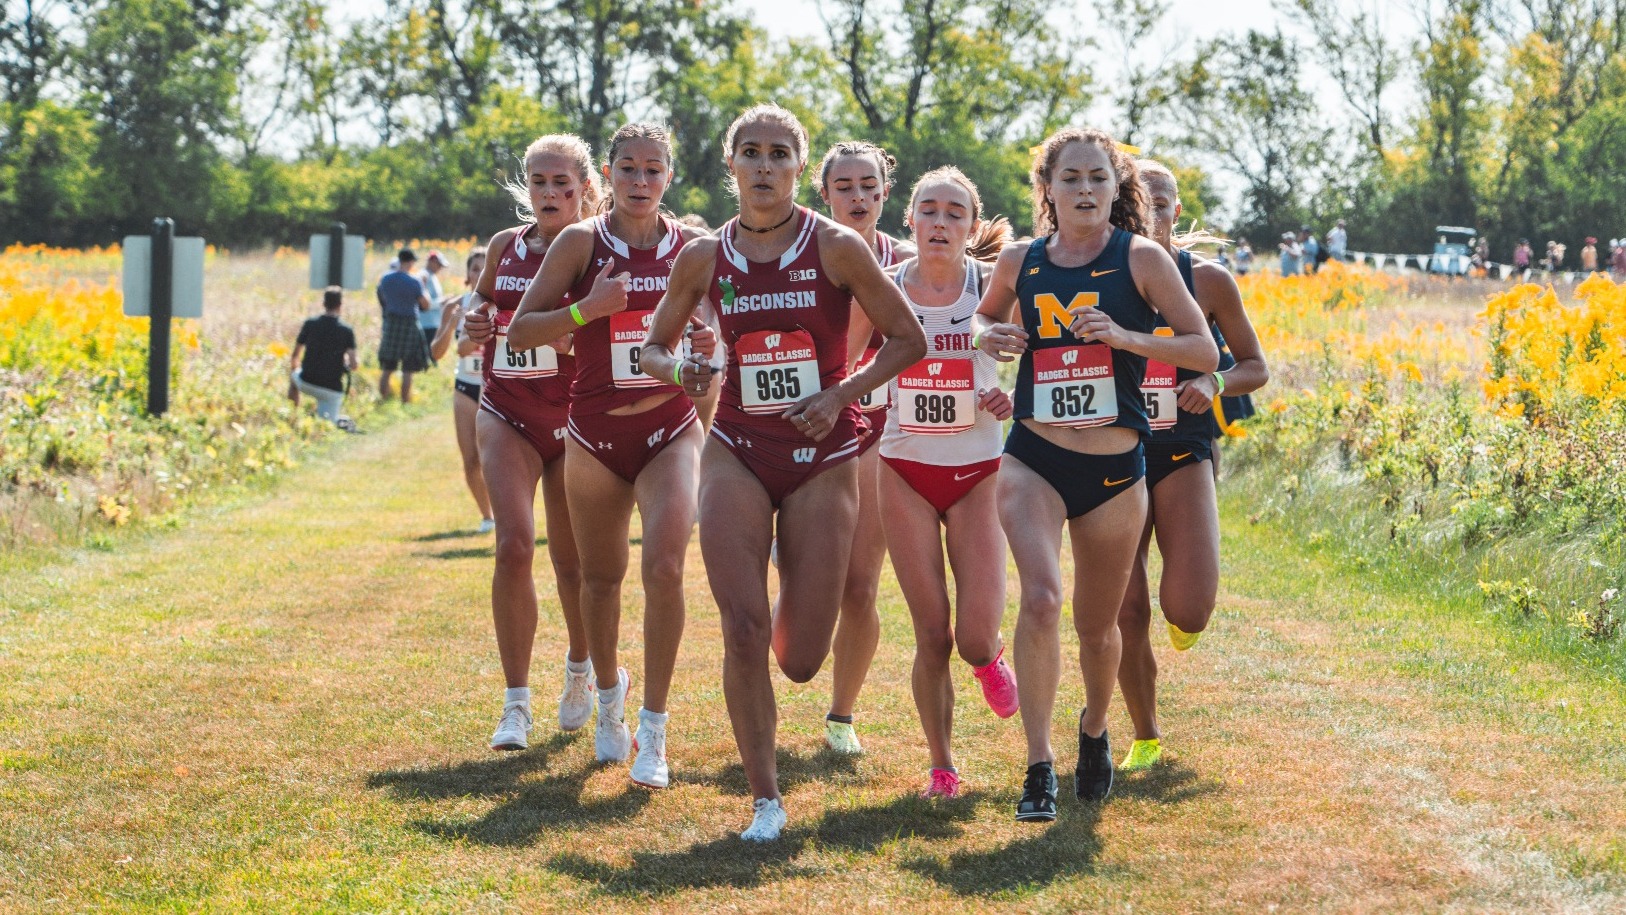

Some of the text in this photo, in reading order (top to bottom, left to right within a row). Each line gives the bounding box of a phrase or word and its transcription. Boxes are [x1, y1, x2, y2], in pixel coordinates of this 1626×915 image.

[721, 290, 817, 315] WISCONSIN
[1033, 292, 1100, 339] M
[764, 334, 782, 350] W
[934, 334, 977, 351] STAT
[742, 349, 812, 364] BADGER CLASSIC
[1062, 350, 1078, 366] W
[928, 362, 942, 376] W
[1037, 366, 1109, 381] BADGER CLASSIC
[756, 368, 801, 401] 935
[901, 378, 970, 388] BADGER CLASSIC
[914, 394, 956, 424] 898
[1051, 384, 1097, 418] 852
[792, 448, 817, 463] W
